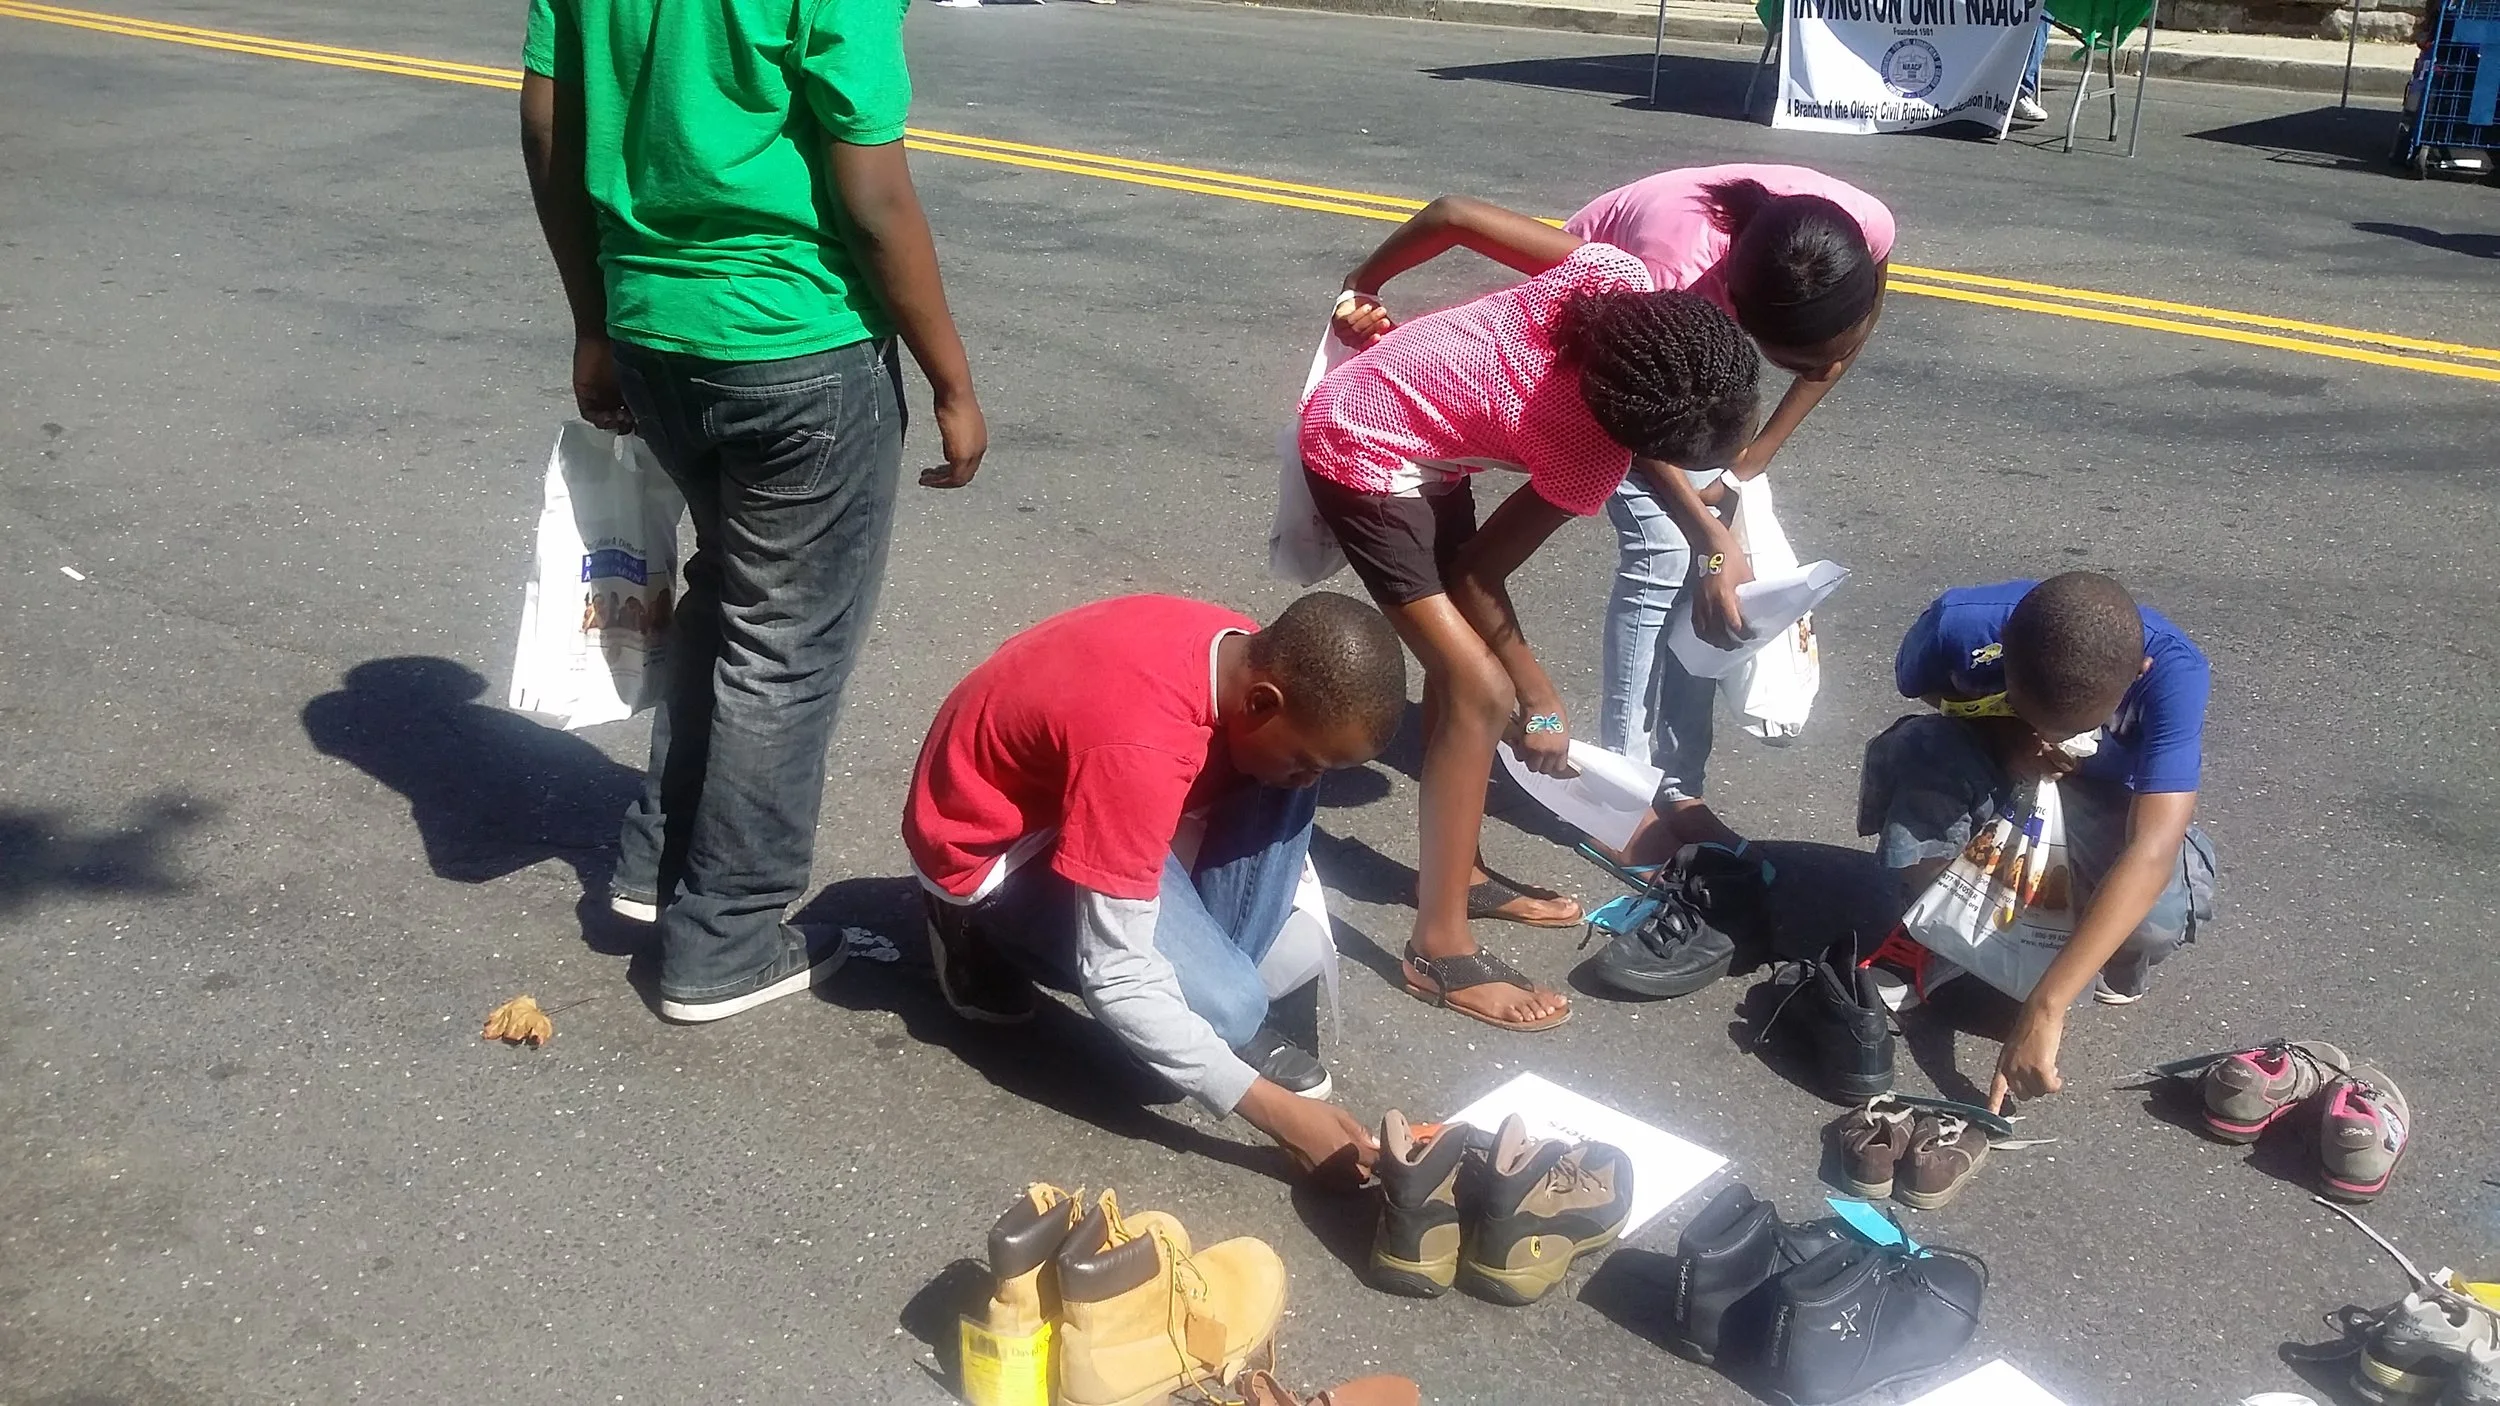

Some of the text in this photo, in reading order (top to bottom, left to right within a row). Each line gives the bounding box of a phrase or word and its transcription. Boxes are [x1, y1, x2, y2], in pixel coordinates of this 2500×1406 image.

[1909, 0, 1955, 26] UNIT
[1965, 0, 2037, 27] NAACP
[1893, 27, 1918, 36] Founded
[1785, 98, 1792, 116] A
[1794, 98, 1822, 118] Branch
[1824, 100, 1833, 118] of
[1835, 100, 1848, 118] the
[1850, 100, 1878, 120] Oldest
[1880, 101, 1901, 120] Civil
[1901, 102, 1930, 124] Rights
[1984, 90, 1993, 110] in
